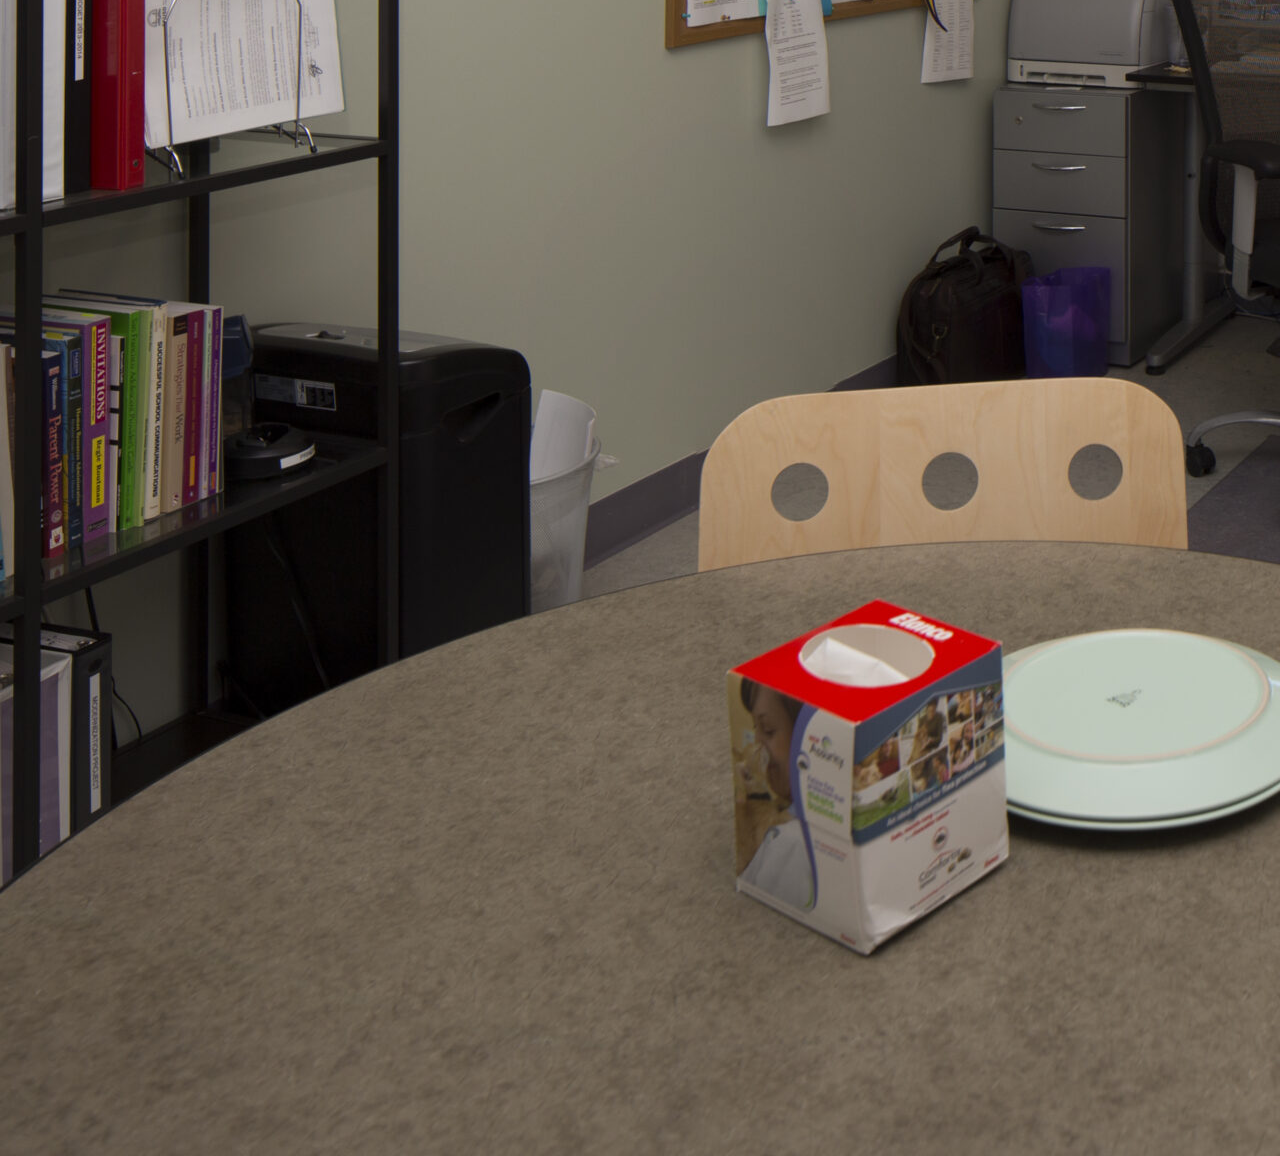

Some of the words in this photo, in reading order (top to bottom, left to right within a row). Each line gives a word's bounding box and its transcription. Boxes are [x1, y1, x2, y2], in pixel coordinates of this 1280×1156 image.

[95, 327, 107, 421] INVITATIONS
[155, 341, 163, 391] SUCCESSFUL
[174, 343, 186, 395] Strategies
[154, 392, 162, 423] SCHOOL
[49, 414, 62, 461] Parent
[175, 414, 184, 444] Work
[94, 439, 103, 463] Regie
[152, 425, 161, 498] COMMUNICATIONS
[49, 462, 62, 504] Power
[94, 464, 103, 504] Routman
[888, 612, 954, 643] Elanco
